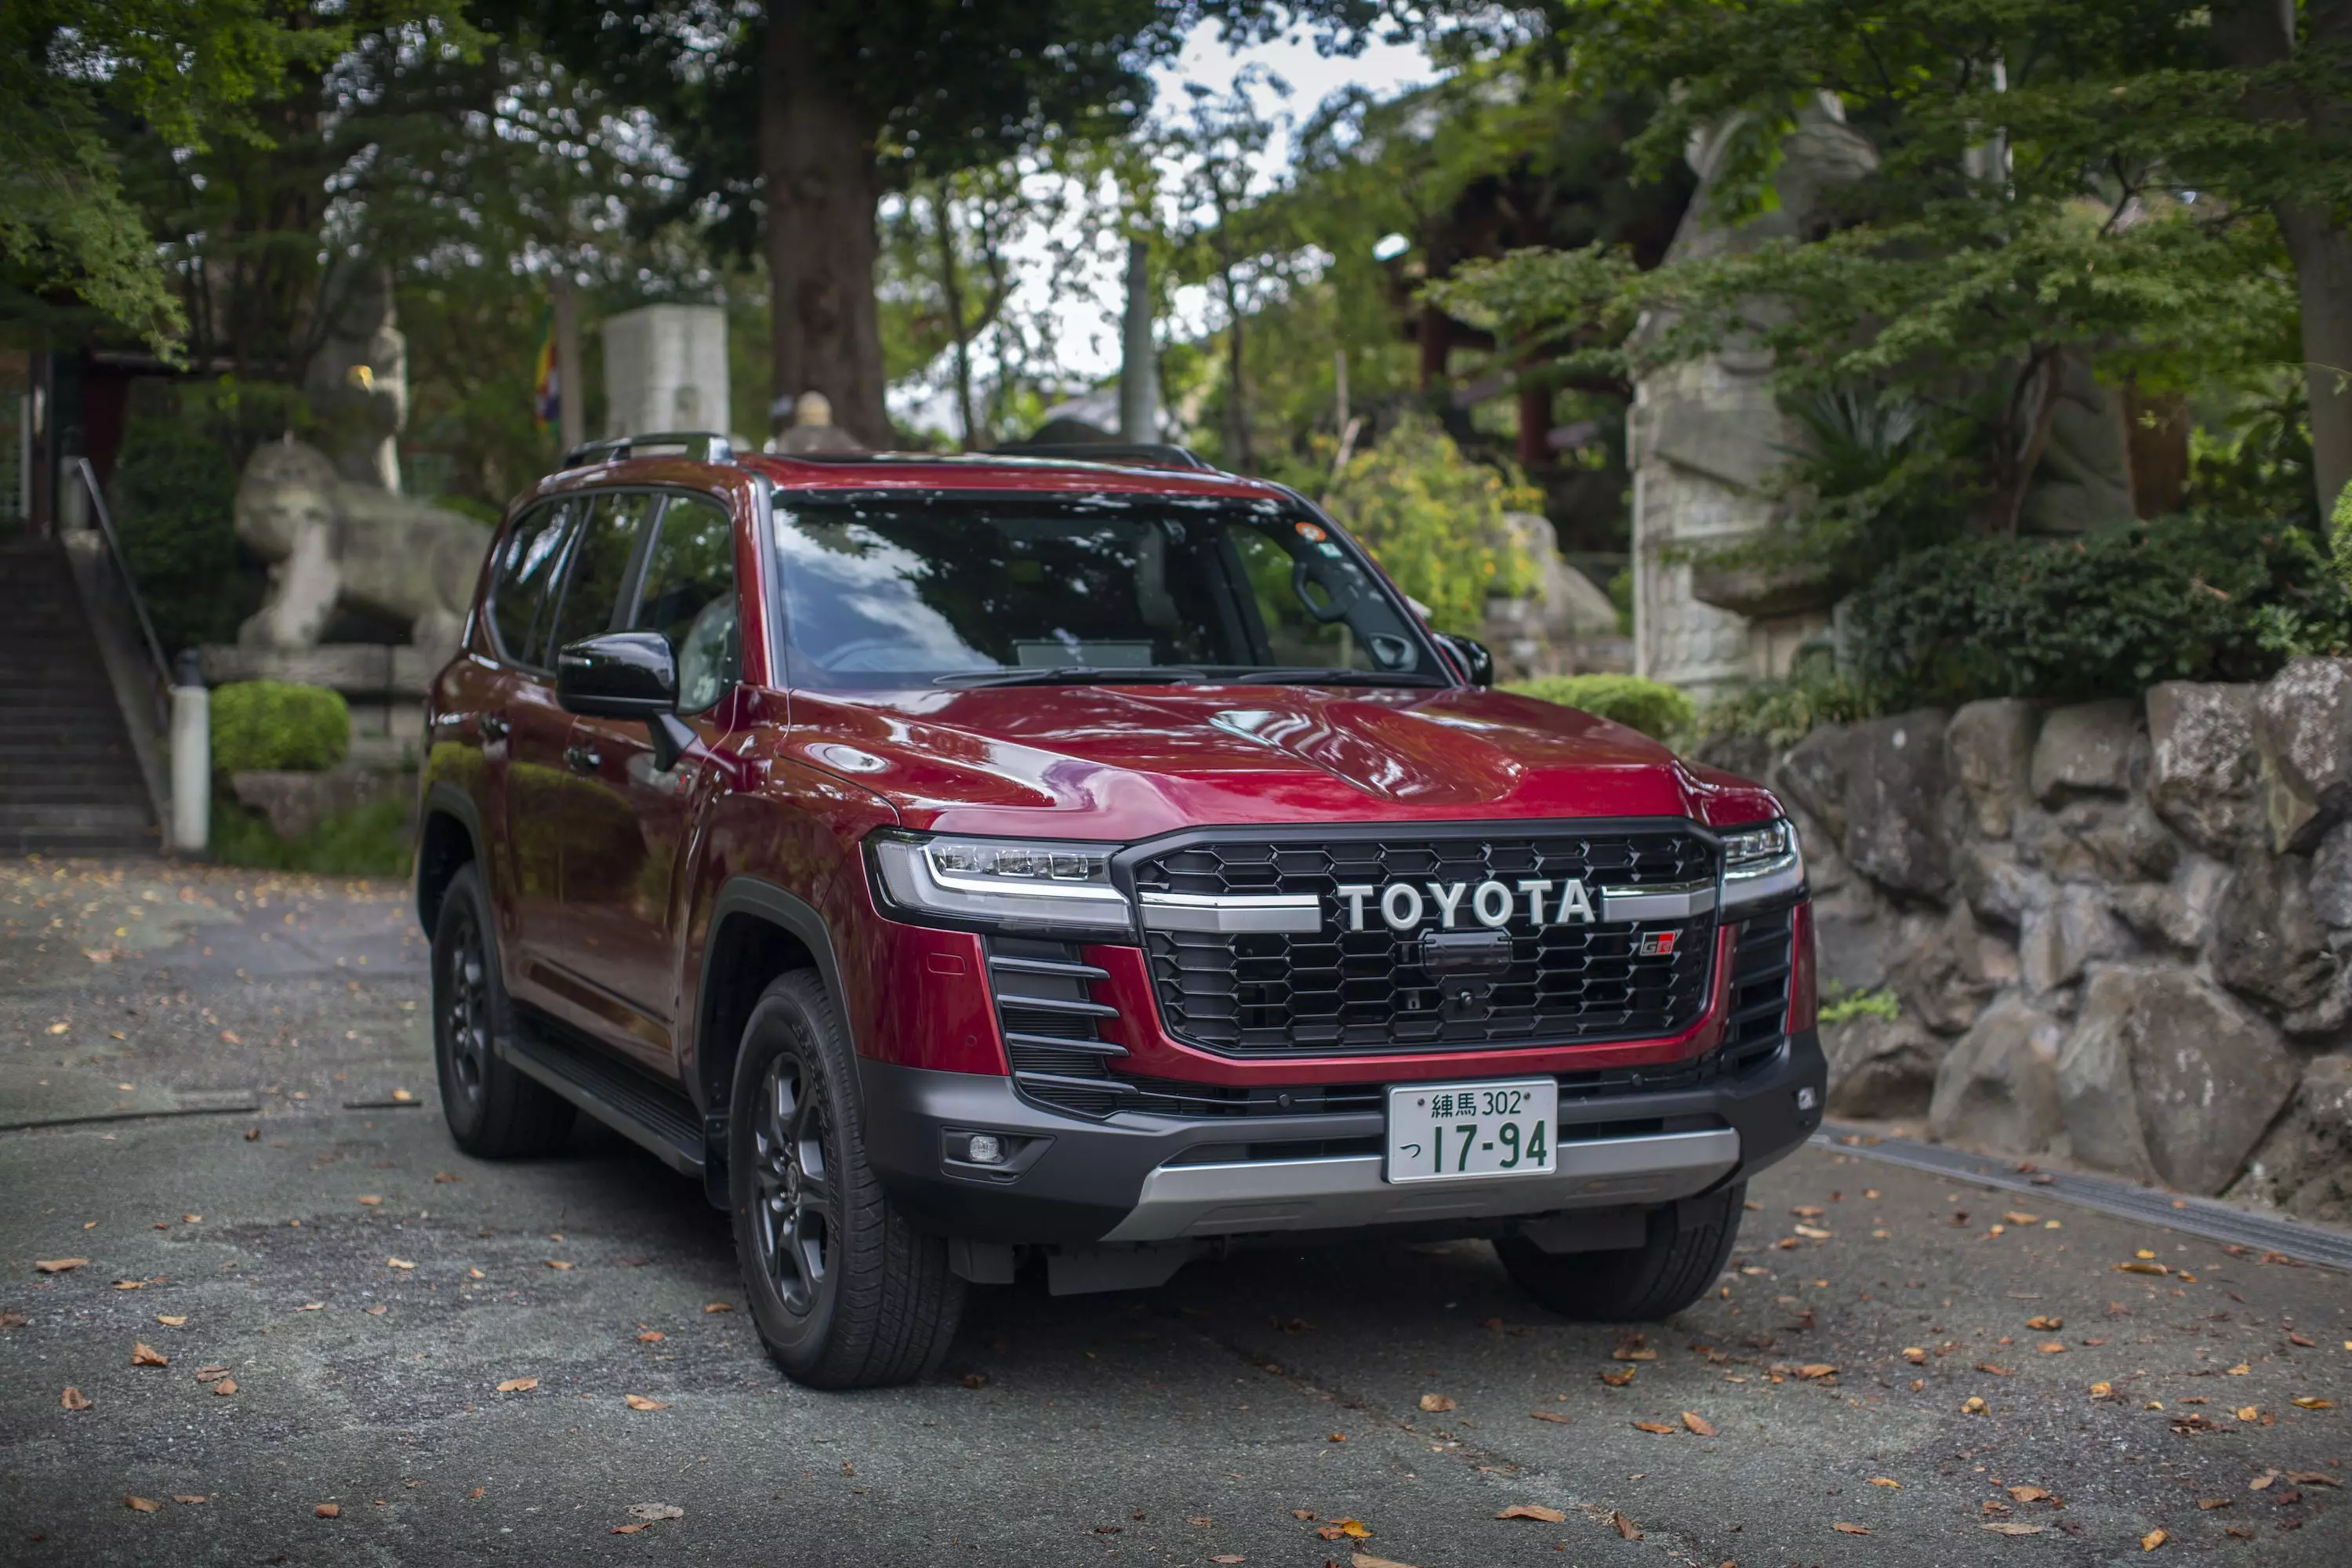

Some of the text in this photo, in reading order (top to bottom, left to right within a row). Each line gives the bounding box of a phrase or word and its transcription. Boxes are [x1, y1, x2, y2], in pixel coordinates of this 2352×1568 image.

[1337, 878, 1595, 931] TOYOTA
[1642, 939, 1672, 954] GR
[1431, 1091, 1521, 1118] 練馬 302
[1399, 1120, 1547, 1173] つ 17-94
